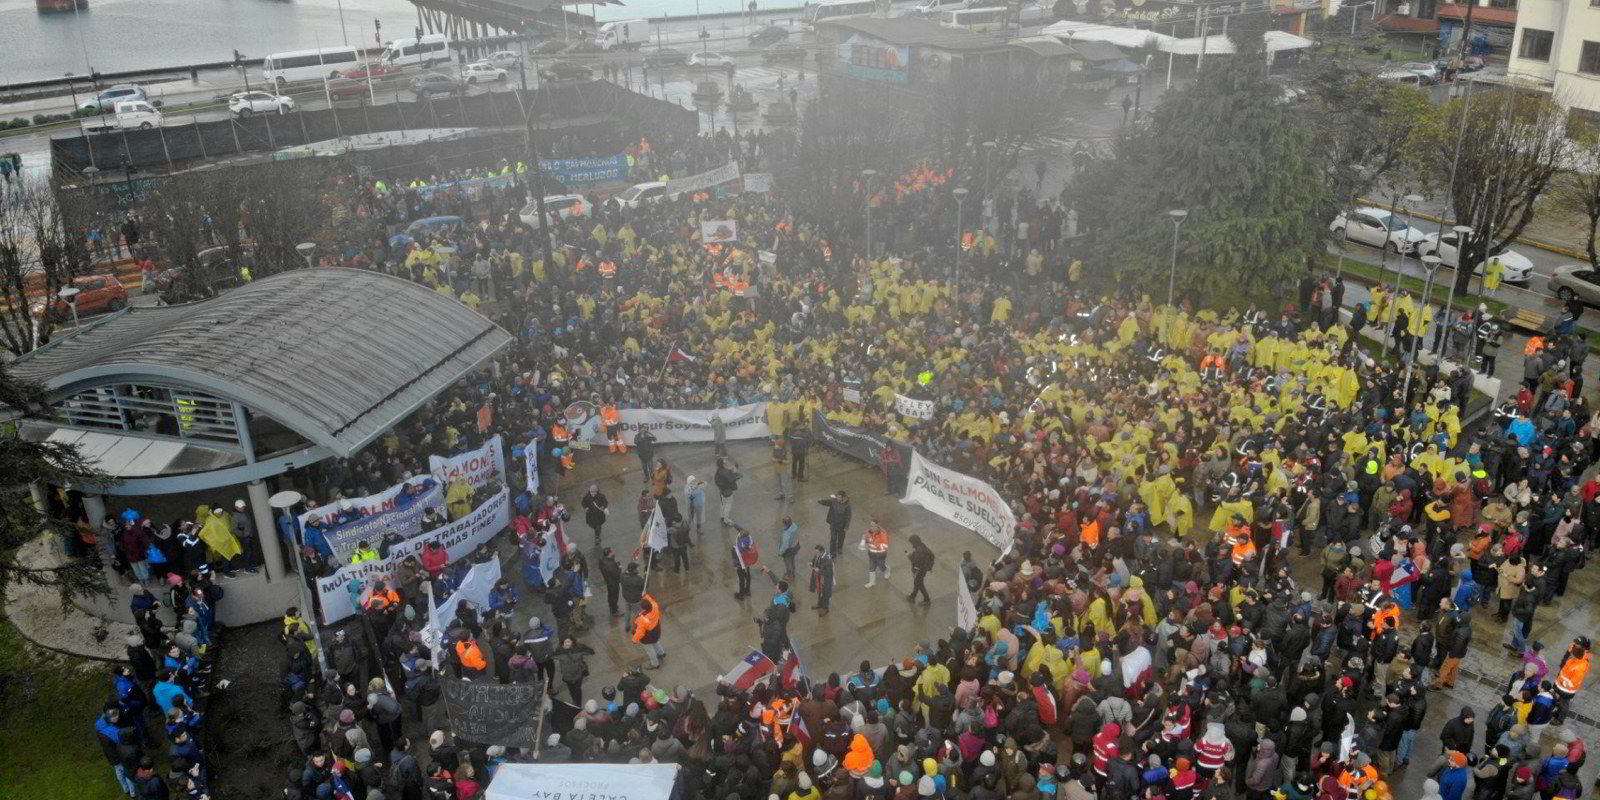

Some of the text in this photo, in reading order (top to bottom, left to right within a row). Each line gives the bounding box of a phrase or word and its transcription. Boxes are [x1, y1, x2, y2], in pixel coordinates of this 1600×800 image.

[914, 475, 946, 501] PAGA
[948, 494, 964, 508] EL
[336, 519, 378, 540] Sindicato
[380, 503, 416, 526] Nacional
[434, 493, 507, 542] TRABAJADORES
[471, 512, 497, 536] FINES
[531, 790, 562, 800] BAY
